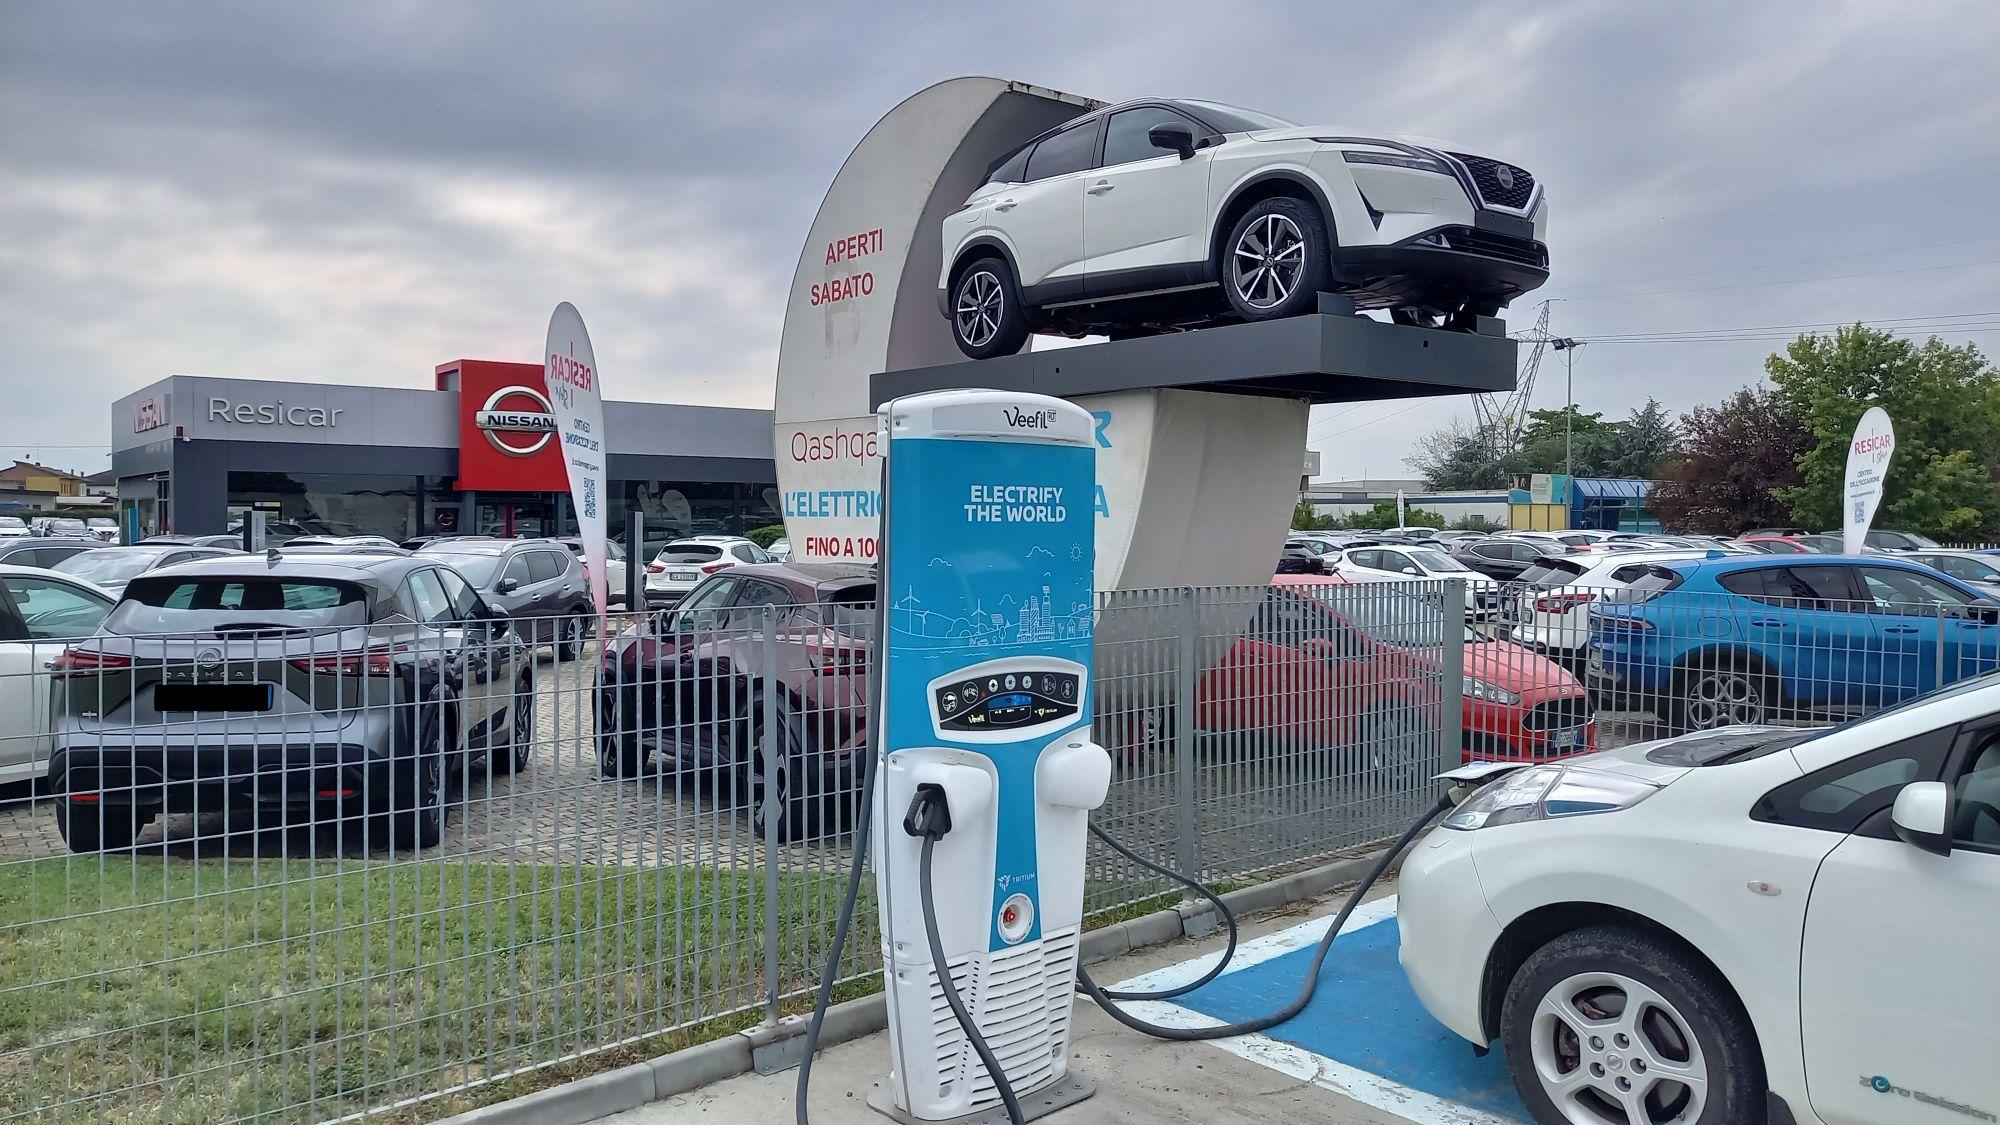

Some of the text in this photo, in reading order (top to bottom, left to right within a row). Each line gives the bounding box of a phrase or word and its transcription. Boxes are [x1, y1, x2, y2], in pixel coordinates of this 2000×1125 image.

[825, 228, 883, 265] APERTI
[810, 272, 874, 306] SABATO
[208, 396, 343, 428] Resicar
[487, 414, 554, 428] NISSAN
[1003, 405, 1048, 429] Veefil
[791, 427, 878, 466] Qashqa
[1854, 434, 1891, 455] RESICAR
[970, 485, 1064, 504] ELECTRIFY
[964, 504, 1067, 523] THE WORLD
[806, 537, 840, 557] FINO
[843, 538, 855, 557] A
[1012, 872, 1035, 884] TRITIUM
